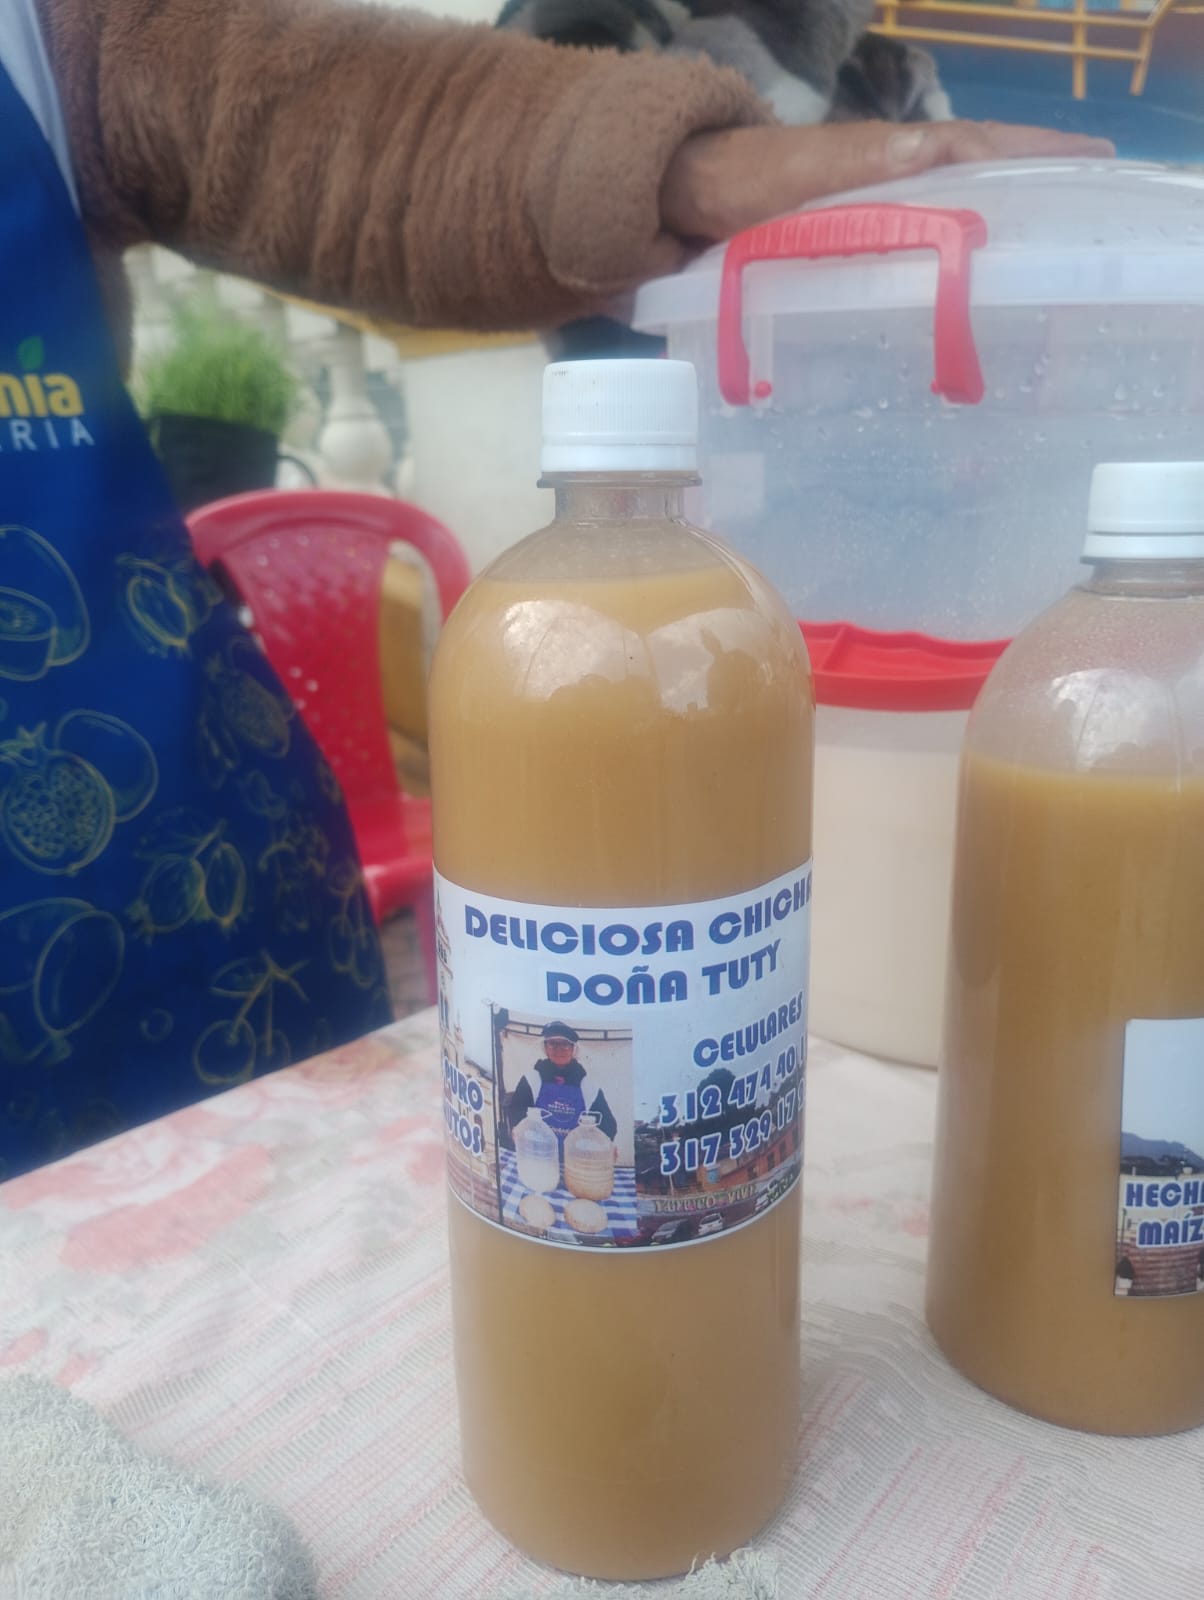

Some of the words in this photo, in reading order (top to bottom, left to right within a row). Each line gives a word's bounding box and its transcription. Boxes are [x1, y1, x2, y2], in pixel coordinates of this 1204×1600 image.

[0, 417, 95, 451] RIA
[465, 904, 694, 956] DELICIOSA
[546, 965, 688, 1006] DOÑA
[701, 938, 782, 996] TUTY
[693, 991, 803, 1068] CELULARES
[444, 1057, 484, 1112] PURO
[660, 1086, 722, 1126] 312
[728, 1063, 771, 1107] 474
[443, 1101, 481, 1154] UTOS
[661, 1133, 721, 1174] 317
[730, 1111, 771, 1158] 329
[1125, 1181, 1204, 1208] HECH
[1138, 1212, 1204, 1246] MAÍZ
